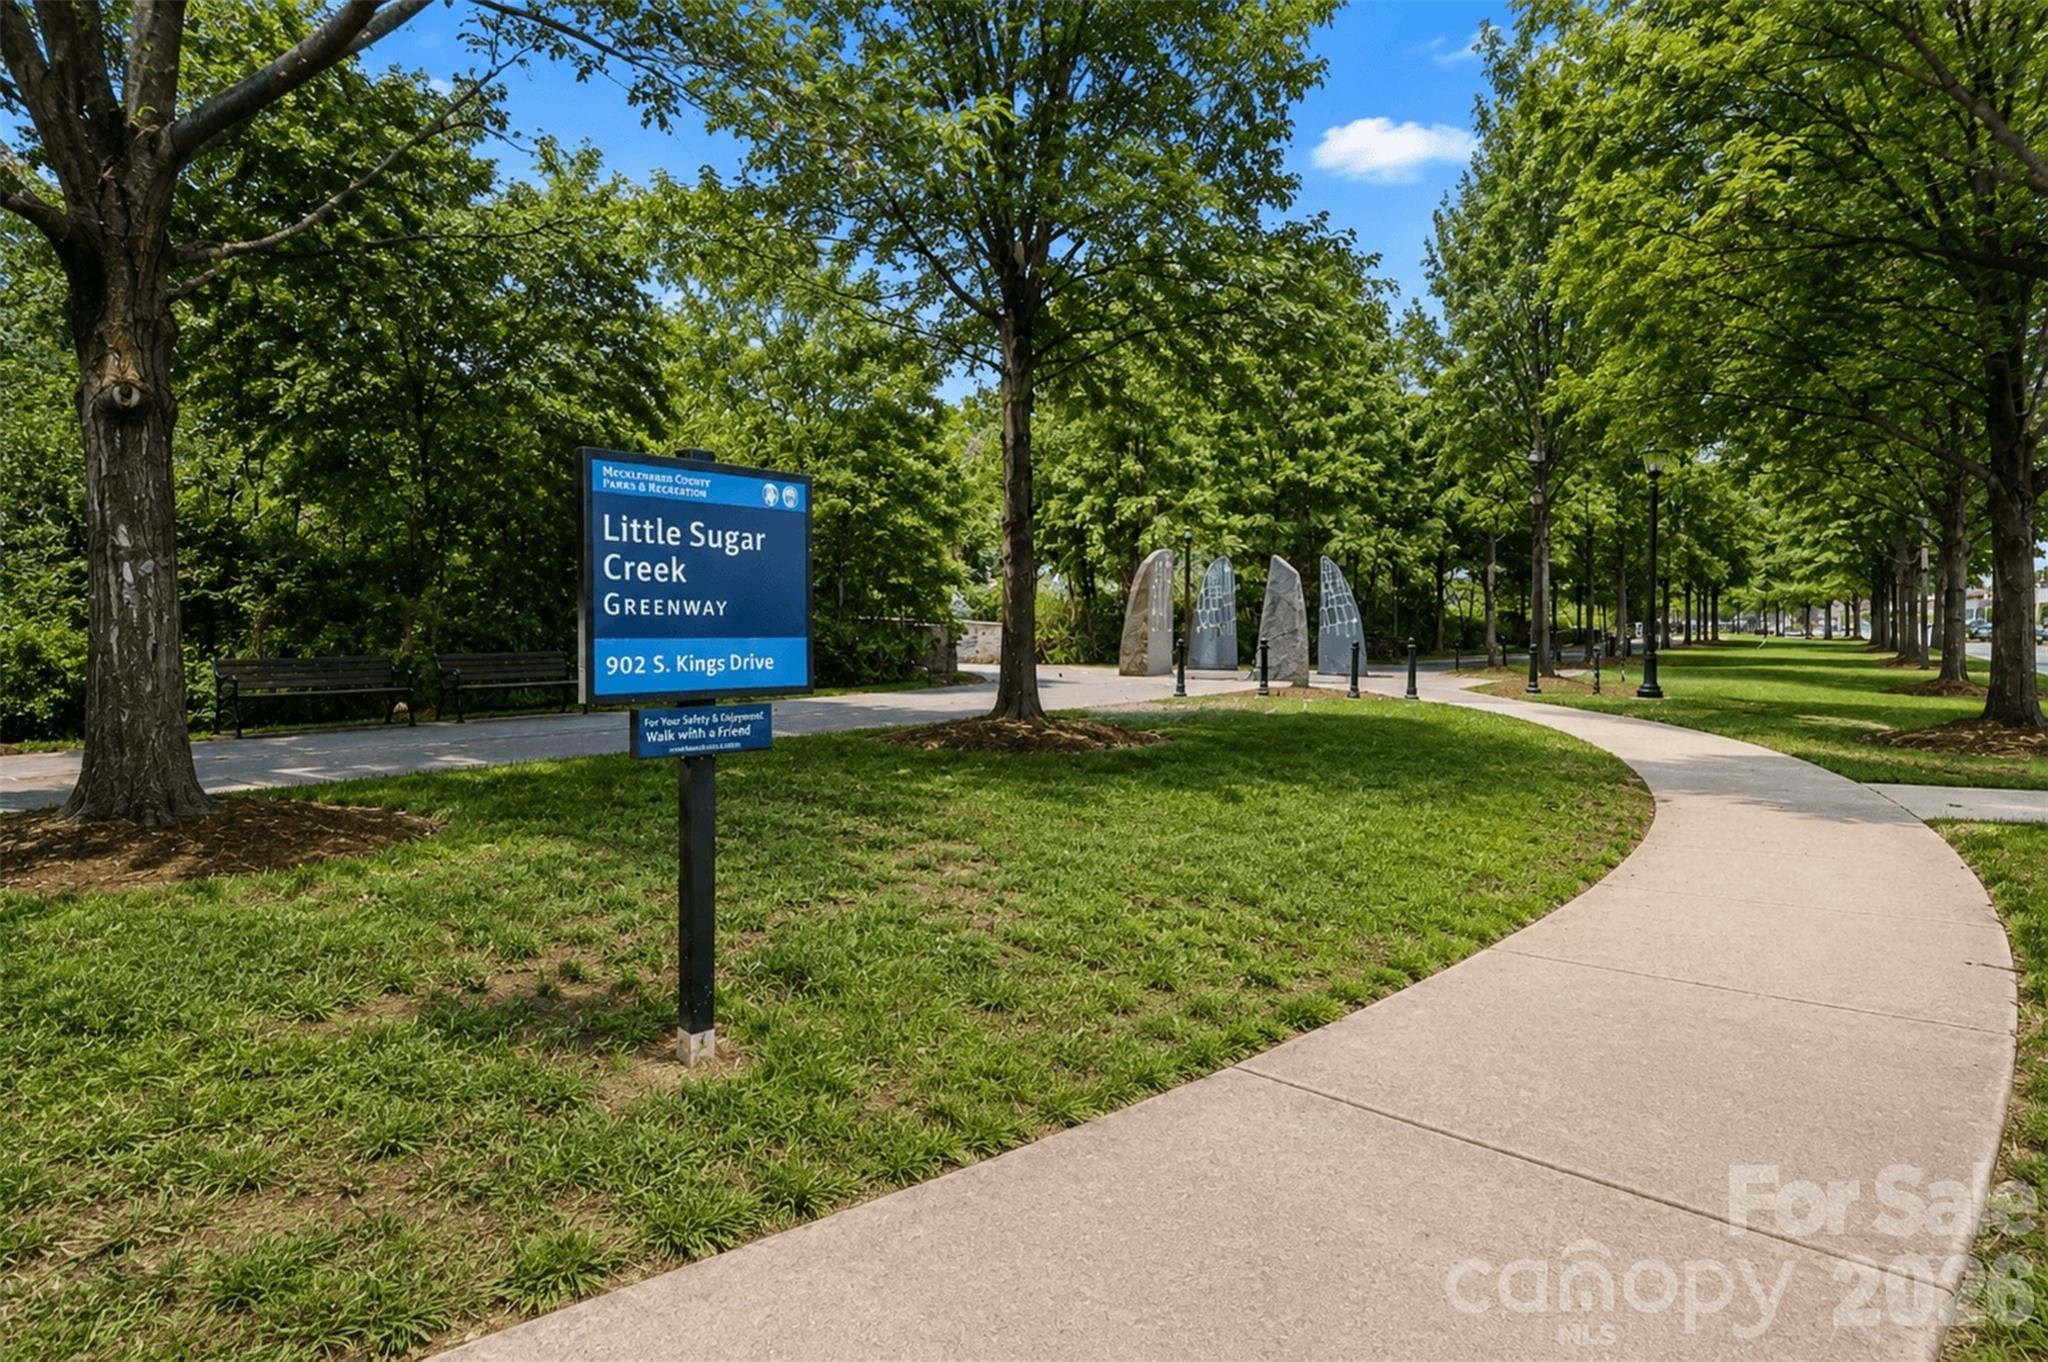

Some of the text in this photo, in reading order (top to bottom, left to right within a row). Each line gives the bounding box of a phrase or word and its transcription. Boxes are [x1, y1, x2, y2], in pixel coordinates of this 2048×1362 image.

[603, 513, 766, 556] Little Sugar
[603, 553, 687, 583] Creek
[603, 592, 728, 617] GREENWAY
[606, 653, 775, 677] 902 S. Kings Drive
[644, 718, 659, 727] For
[660, 716, 680, 727] Your
[646, 729, 675, 743] Walk
[709, 730, 716, 738] a
[717, 724, 751, 738] Friend
